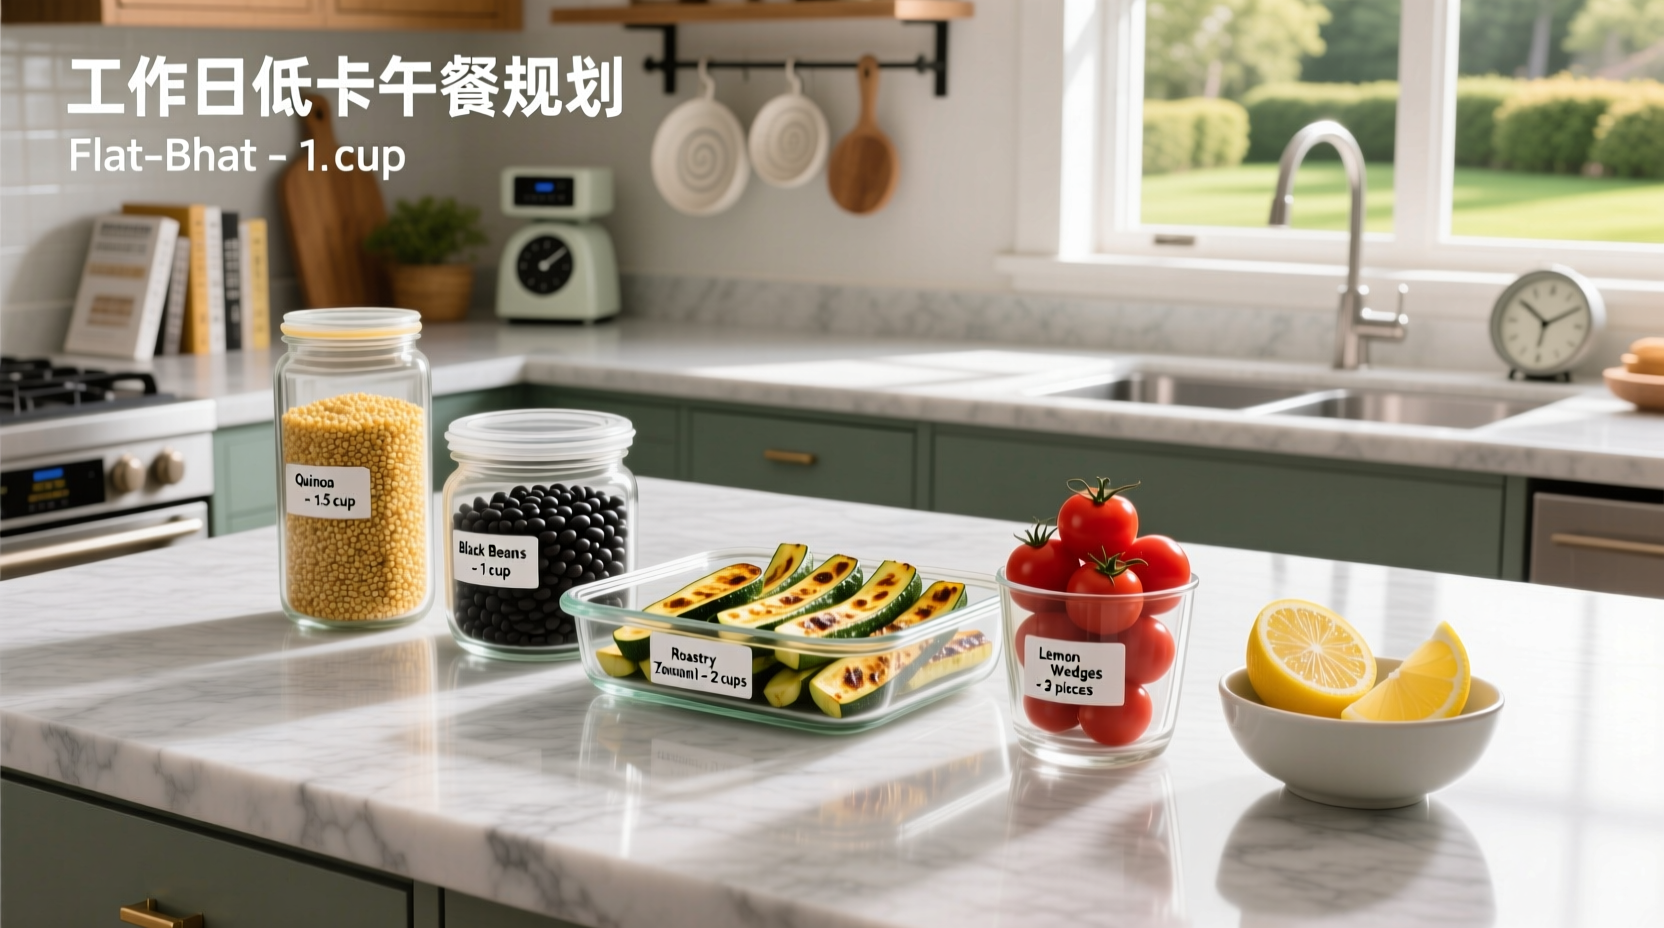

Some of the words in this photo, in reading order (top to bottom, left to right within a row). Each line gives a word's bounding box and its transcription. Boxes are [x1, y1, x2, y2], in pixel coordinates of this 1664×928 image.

[295, 472, 335, 489] Quinoa
[332, 496, 356, 511] cup
[458, 540, 485, 557] Black
[488, 544, 527, 560] Beans
[480, 562, 486, 576] 1
[488, 566, 511, 581] cup
[671, 646, 717, 669] Roastry
[1039, 646, 1081, 663] Lemon
[710, 670, 719, 684] 2
[720, 675, 747, 689] cups
[1050, 664, 1103, 682] Wedges
[1044, 679, 1052, 692] 3
